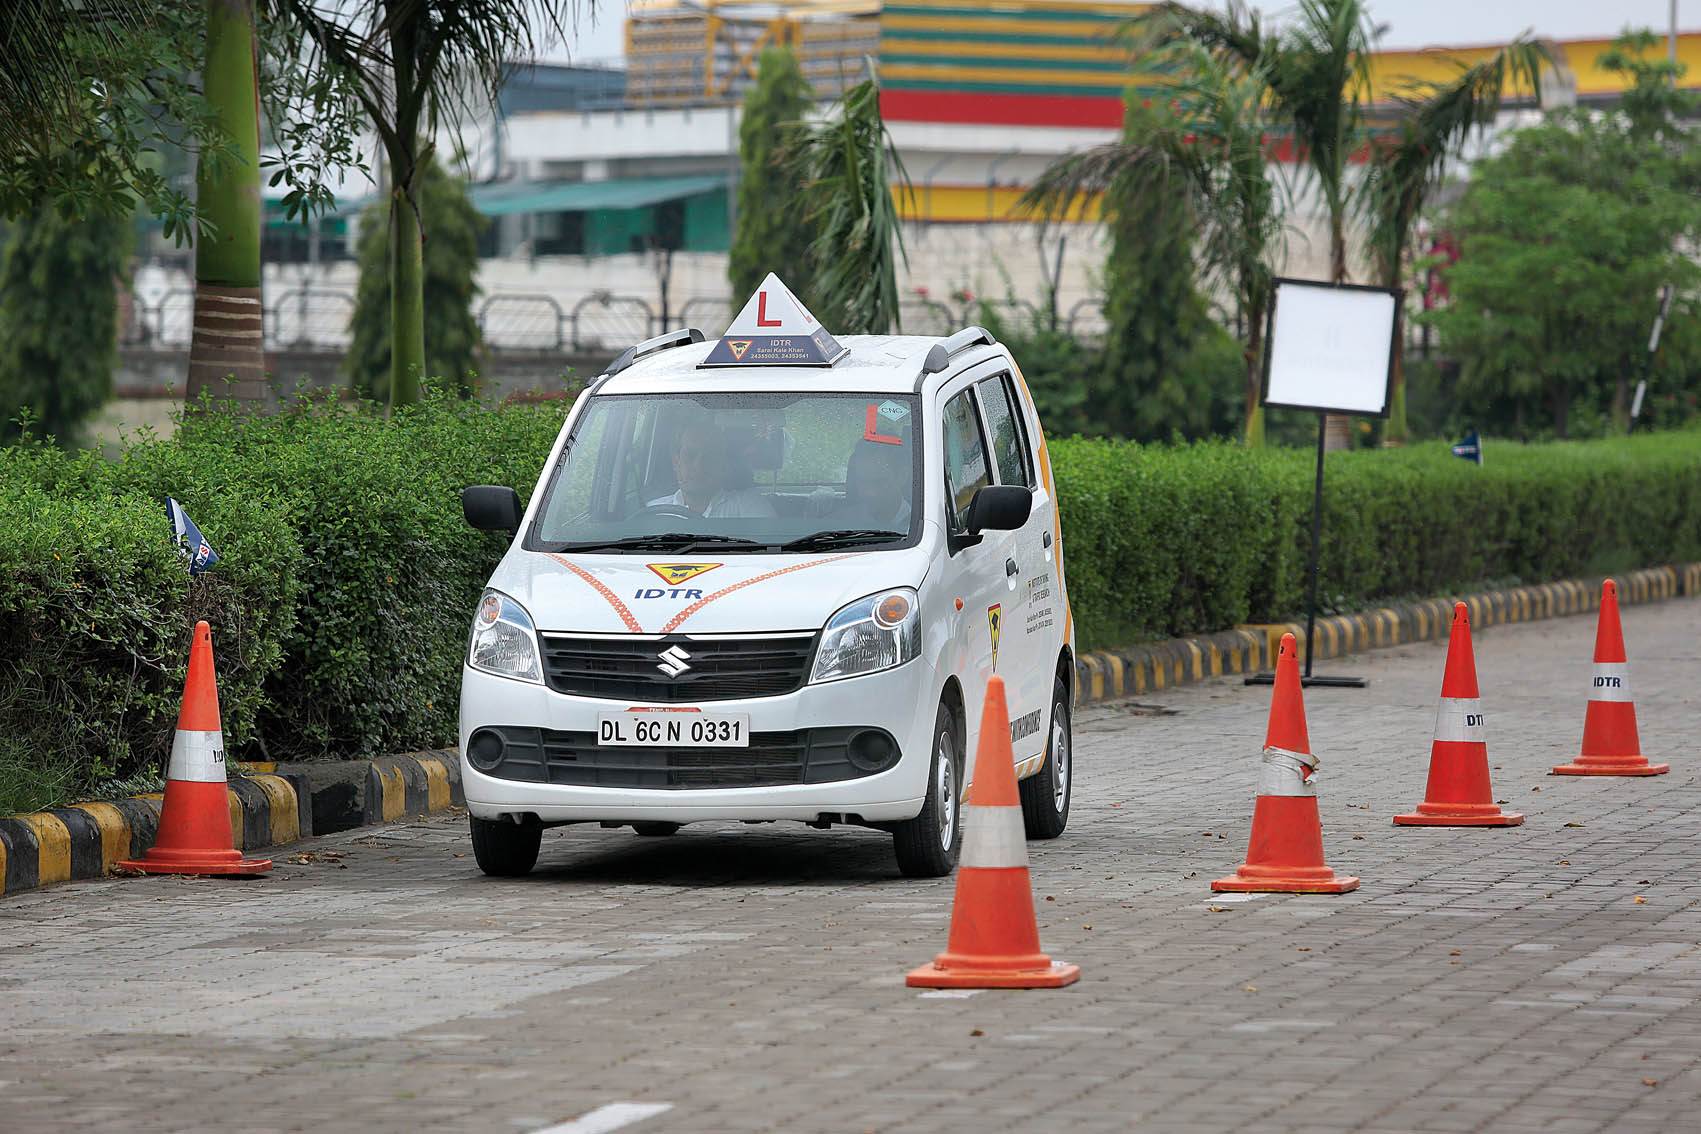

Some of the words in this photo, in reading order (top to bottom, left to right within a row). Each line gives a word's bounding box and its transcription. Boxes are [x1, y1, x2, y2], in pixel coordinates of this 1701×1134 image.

[757, 291, 782, 327] L
[770, 339, 792, 347] IDTR
[864, 403, 903, 446] L
[635, 588, 703, 599] IDTR
[1593, 676, 1621, 688] IDTR
[1466, 714, 1484, 727] DT
[601, 720, 627, 742] DL
[691, 720, 740, 743] 0331
